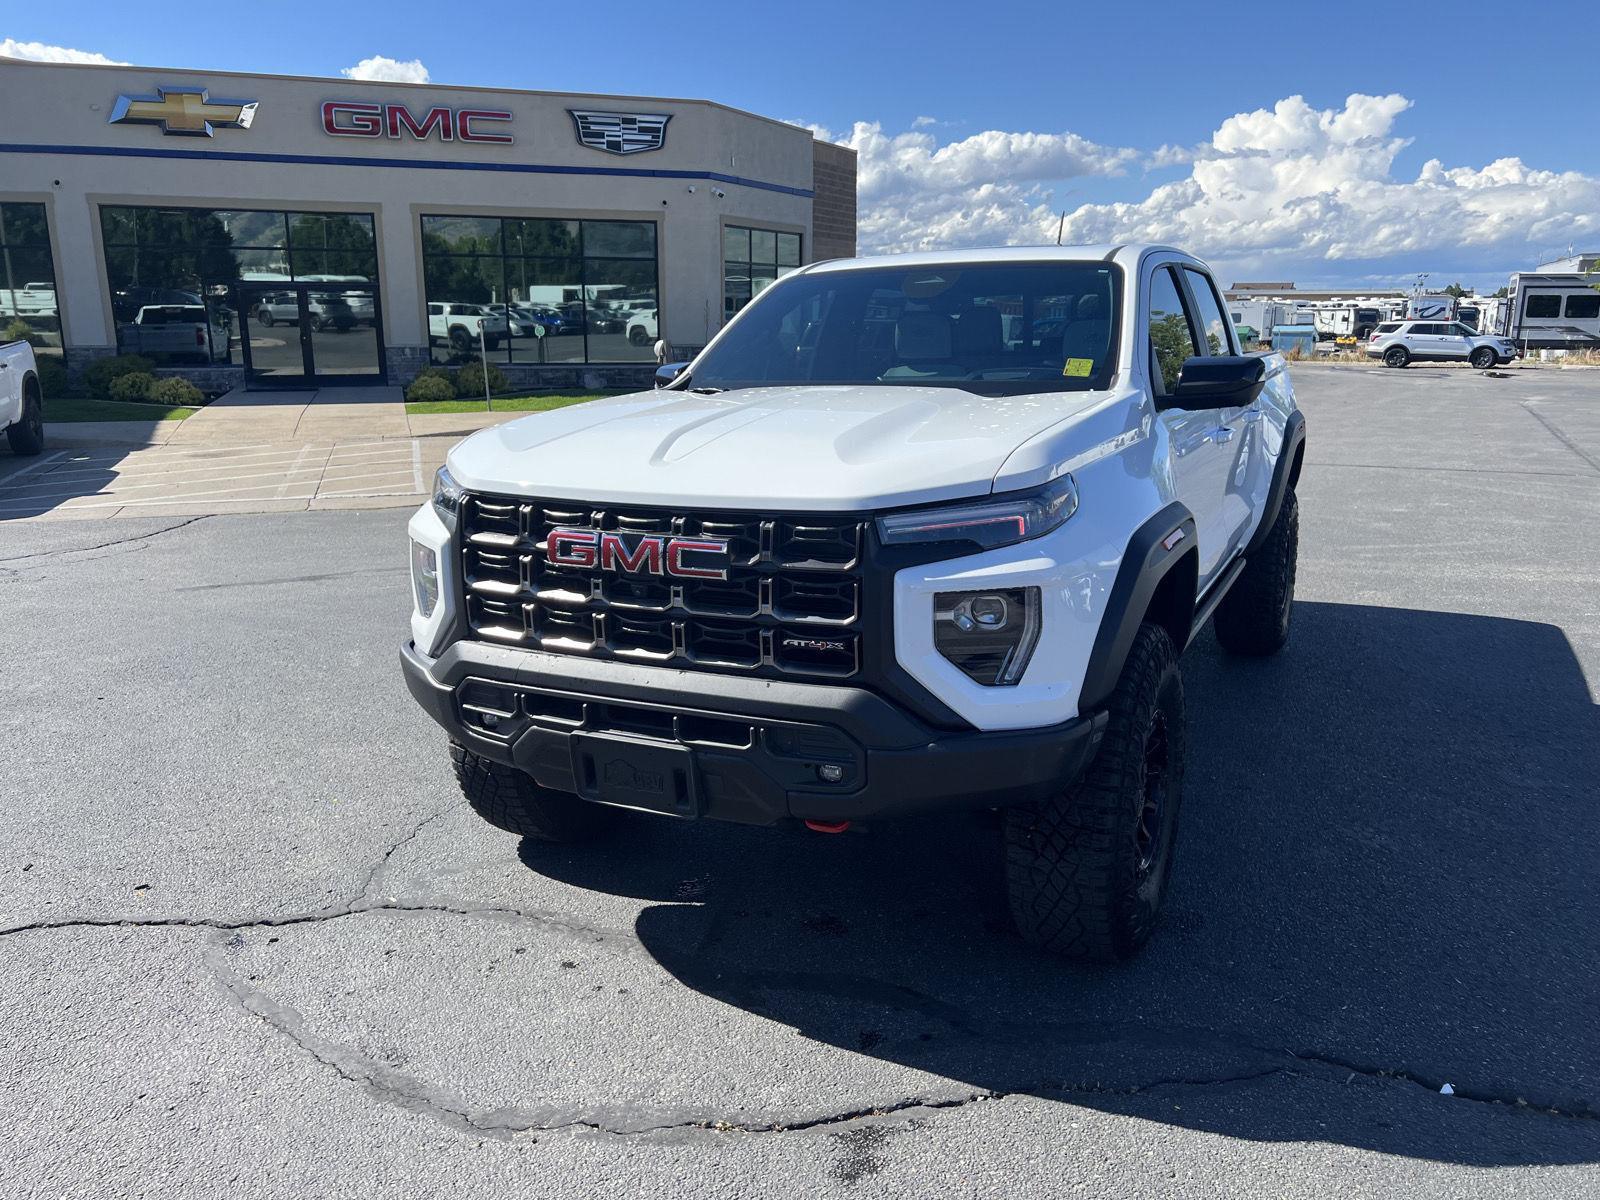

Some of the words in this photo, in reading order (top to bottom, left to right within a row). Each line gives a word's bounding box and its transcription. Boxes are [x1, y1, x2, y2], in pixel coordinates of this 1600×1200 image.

[321, 101, 514, 144] GMC
[547, 529, 727, 581] GMC
[782, 639, 844, 651] AT4X
